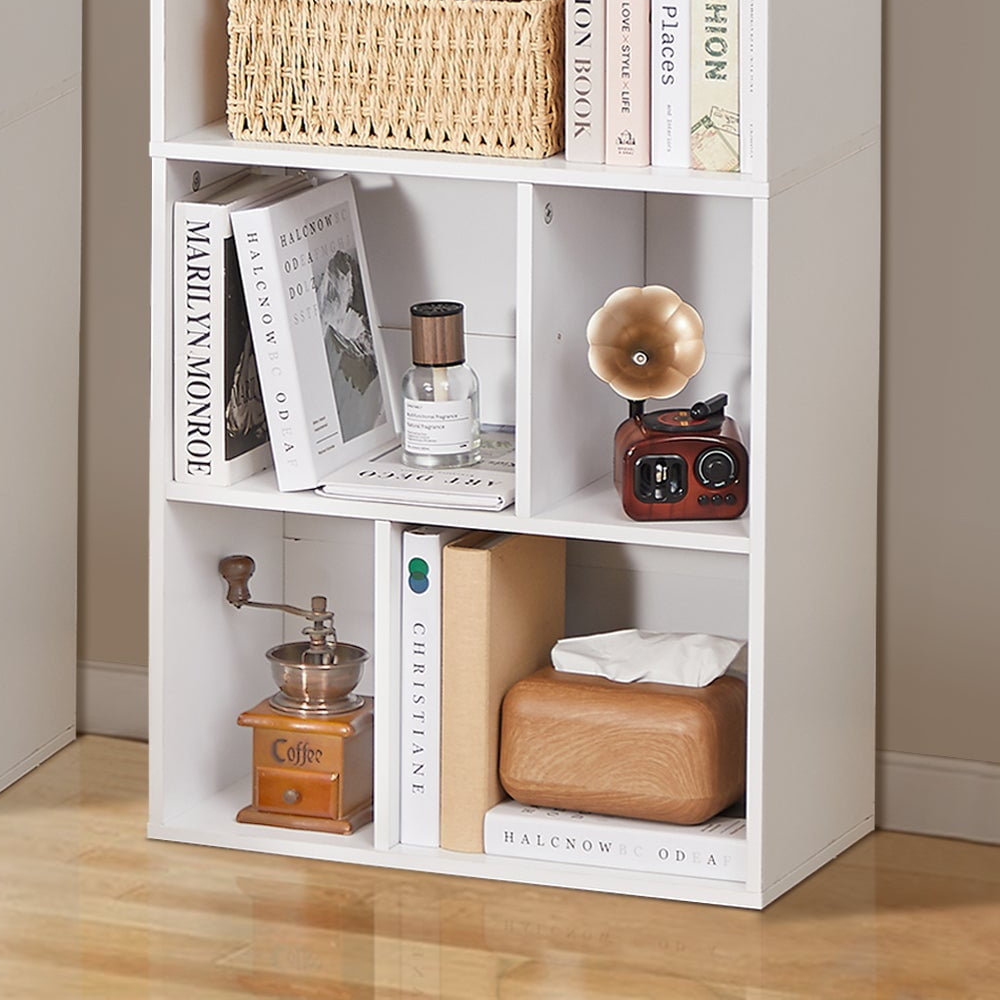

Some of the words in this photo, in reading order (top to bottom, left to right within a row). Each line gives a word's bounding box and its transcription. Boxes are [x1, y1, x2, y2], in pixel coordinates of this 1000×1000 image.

[620, 3, 630, 33] LOVE
[661, 6, 678, 86] Places
[574, 58, 593, 139] BOOK
[620, 45, 630, 79] STYLE
[620, 91, 630, 114] LIFE
[186, 219, 212, 349] MARILYN
[186, 351, 212, 477] MONROE
[411, 622, 427, 795] CHRISTIANE
[272, 738, 323, 766] Coffee
